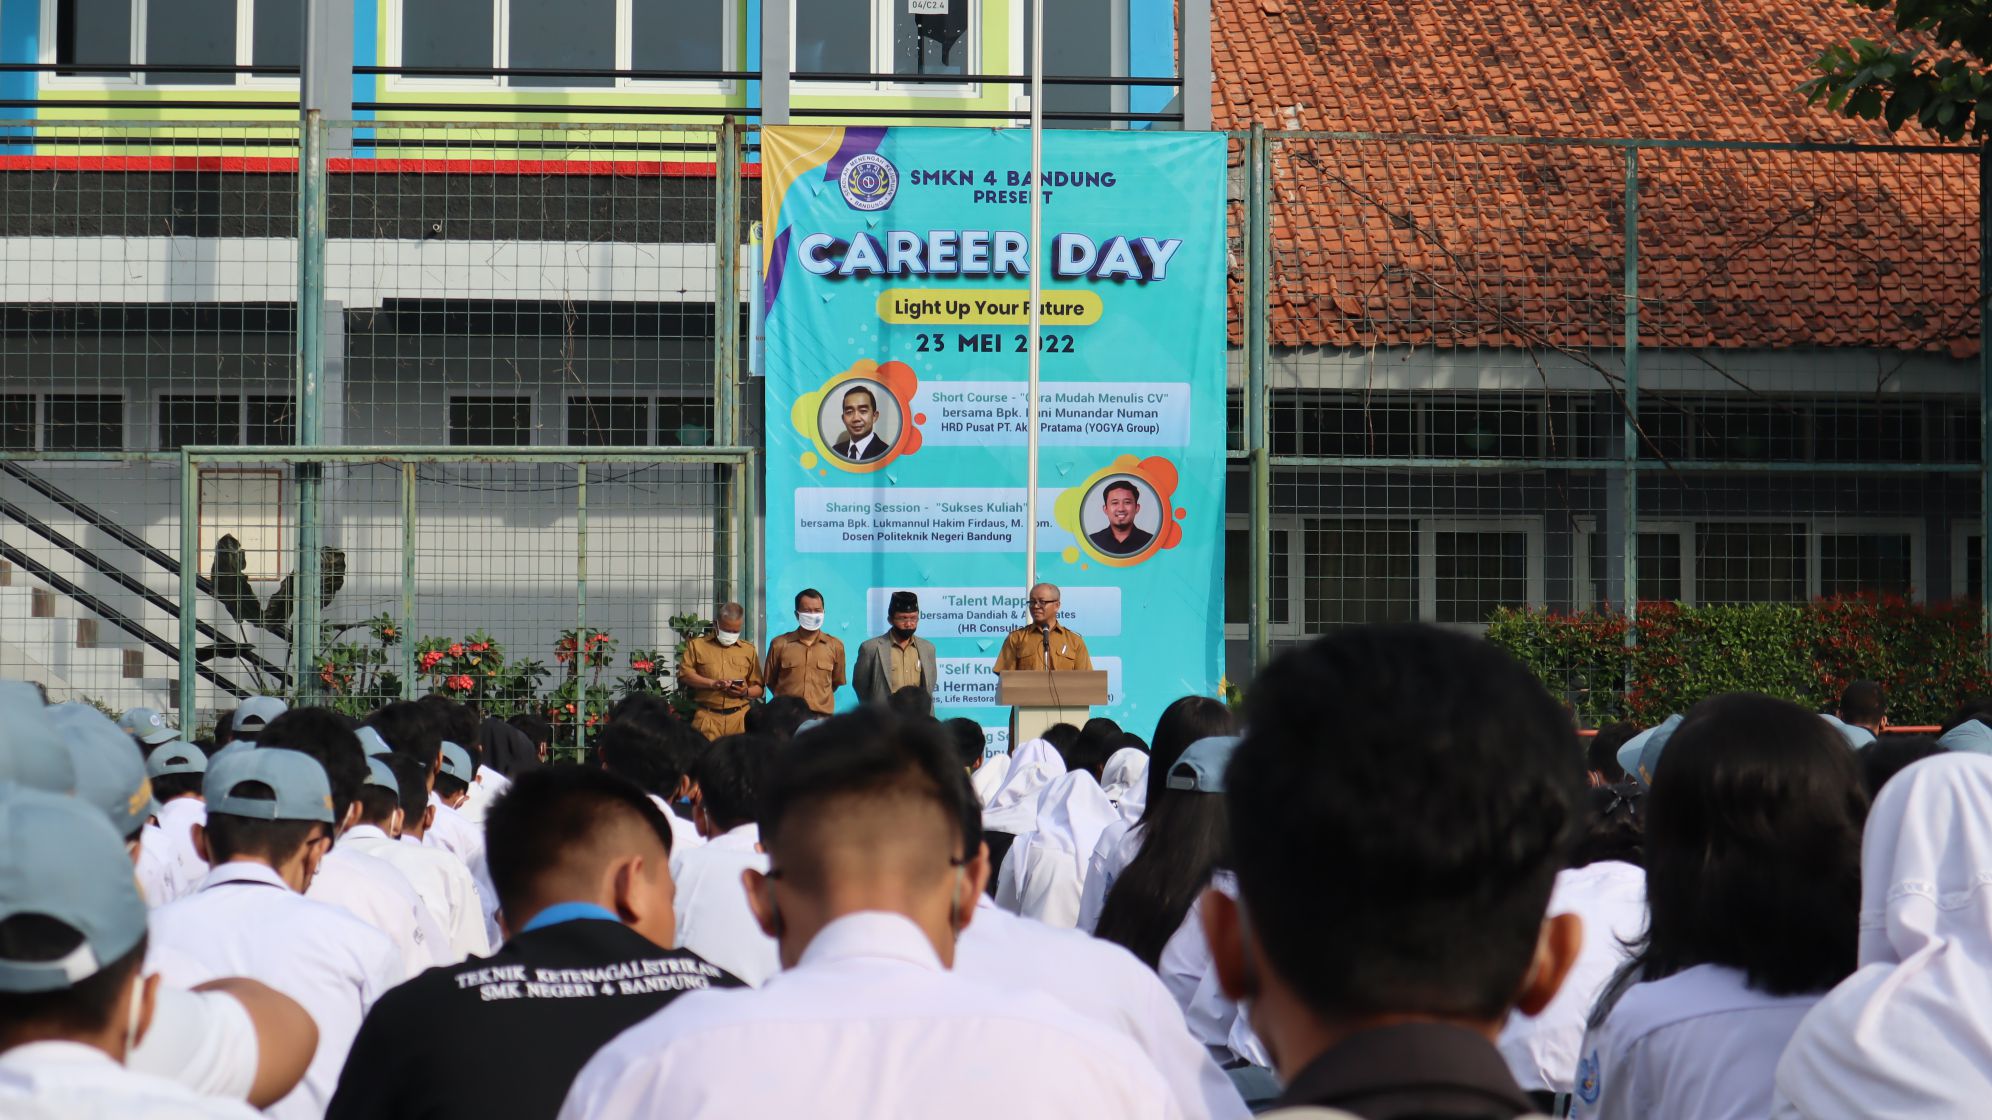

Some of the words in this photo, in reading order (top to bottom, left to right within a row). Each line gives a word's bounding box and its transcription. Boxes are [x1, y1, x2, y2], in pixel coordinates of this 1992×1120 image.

[910, 170, 974, 186] SMKN
[983, 170, 998, 186] 4
[974, 190, 1053, 204] PRESET
[798, 229, 1031, 279] CAREER
[1056, 232, 1184, 282] DAY
[895, 299, 941, 320] Light
[946, 300, 971, 320] Up
[975, 300, 1019, 316] Your
[915, 333, 945, 352] 23
[958, 333, 1001, 353] MEI
[931, 392, 964, 403] Short
[967, 393, 1008, 403] Course
[1055, 393, 1095, 403] Mudah
[1098, 392, 1144, 404] Menulis
[1146, 393, 1169, 404] CV"
[942, 407, 993, 418] bersama
[996, 407, 1022, 421] Bpk.
[1055, 408, 1114, 419] Munandar
[1117, 408, 1159, 419] Numan
[941, 422, 964, 432] HRD
[966, 422, 995, 432] Pusat
[997, 422, 1013, 432] PT.
[1040, 422, 1083, 433] Pratama
[1085, 422, 1124, 435] (YOGYA
[1126, 422, 1160, 435] Group)
[825, 502, 871, 515] Sharing
[874, 502, 921, 513] Session
[936, 502, 983, 513] "Sukses
[986, 501, 1028, 513] Kuliah"
[800, 518, 845, 528] bersama
[847, 518, 870, 530] Bpk.
[873, 518, 930, 528] Lukmannul
[932, 518, 965, 528] Hakim
[968, 518, 1008, 529] Firdaus,
[1011, 518, 1024, 528] M.
[842, 531, 875, 541] Dosen
[877, 531, 928, 541] Politeknik
[931, 532, 964, 543] Negeri
[967, 531, 1012, 543] Bandung
[942, 595, 988, 607] "Talent
[919, 610, 964, 620] bersama
[966, 610, 1008, 620] Dandiah
[1011, 610, 1018, 620] &
[957, 623, 977, 635] (HR
[939, 663, 970, 675] "Self
[944, 695, 961, 703] Life
[455, 964, 527, 989] TEKNIK
[480, 982, 523, 1001] SMK
[527, 982, 597, 999] NEGERI
[600, 982, 615, 996] 4
[618, 973, 710, 996] BANDUNG
